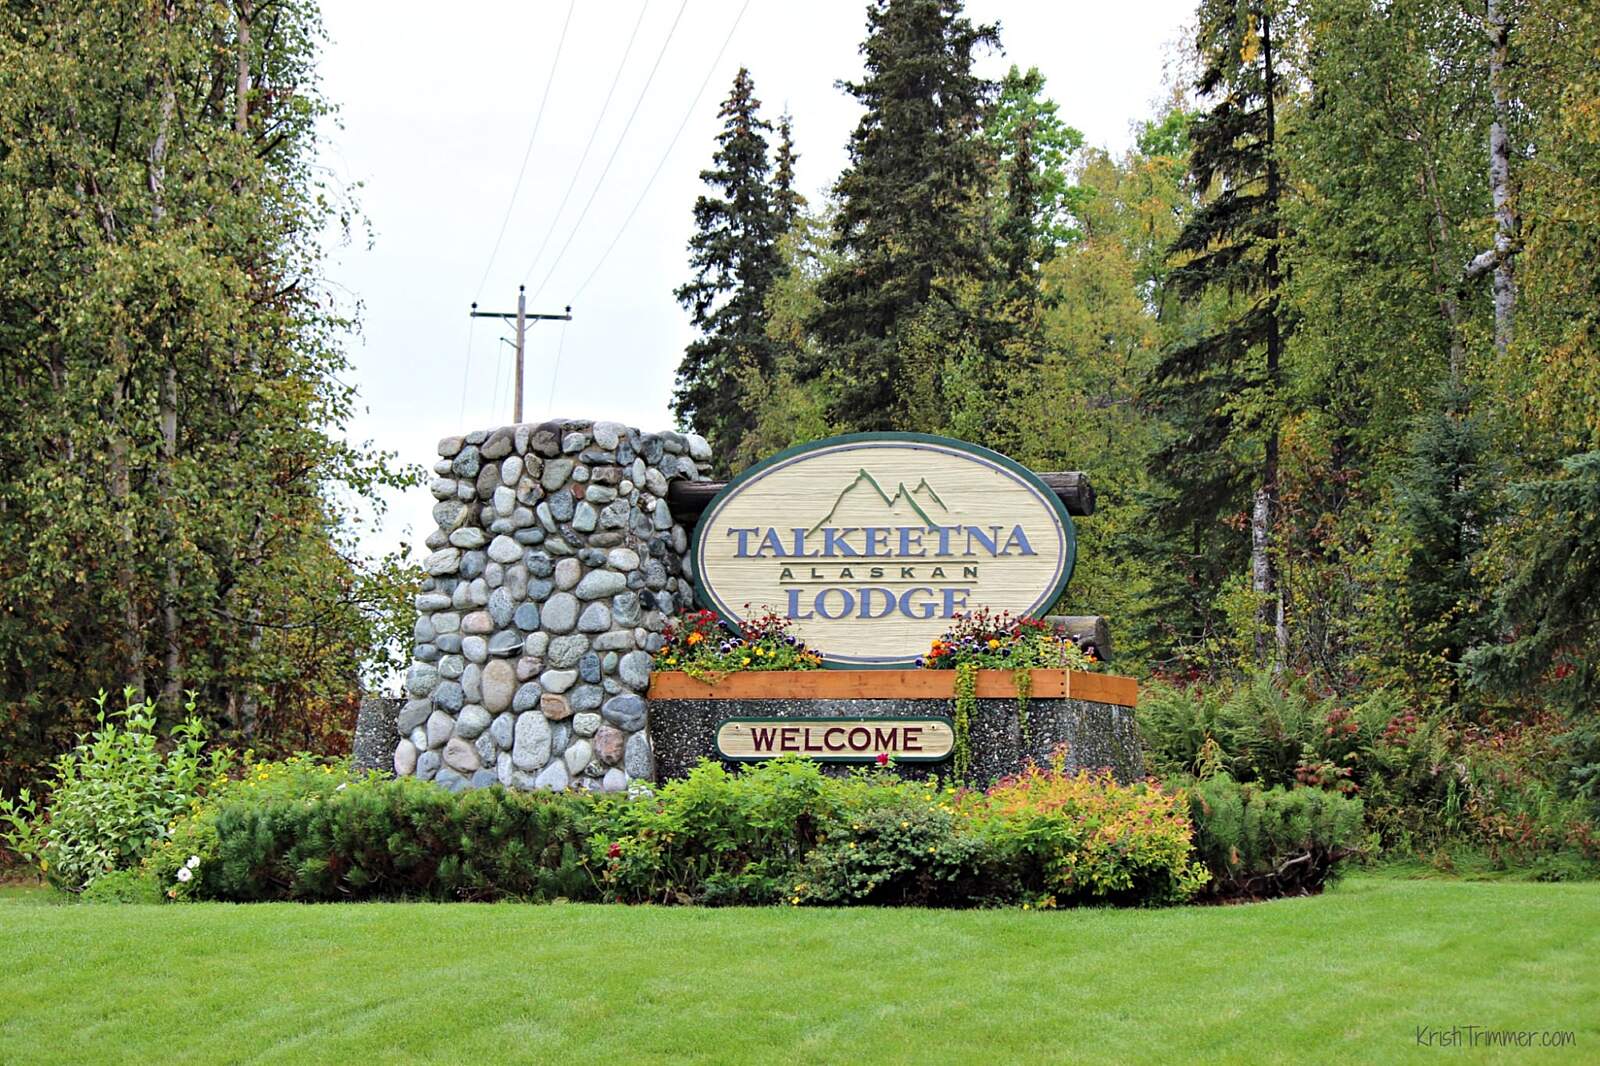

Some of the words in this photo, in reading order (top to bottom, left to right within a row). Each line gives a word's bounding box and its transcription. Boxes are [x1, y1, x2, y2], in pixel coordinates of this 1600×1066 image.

[727, 524, 1037, 558] TALKEETNA
[780, 566, 978, 579] ALASKAN
[784, 587, 972, 620] LODGE
[750, 727, 923, 751] WELCOME
